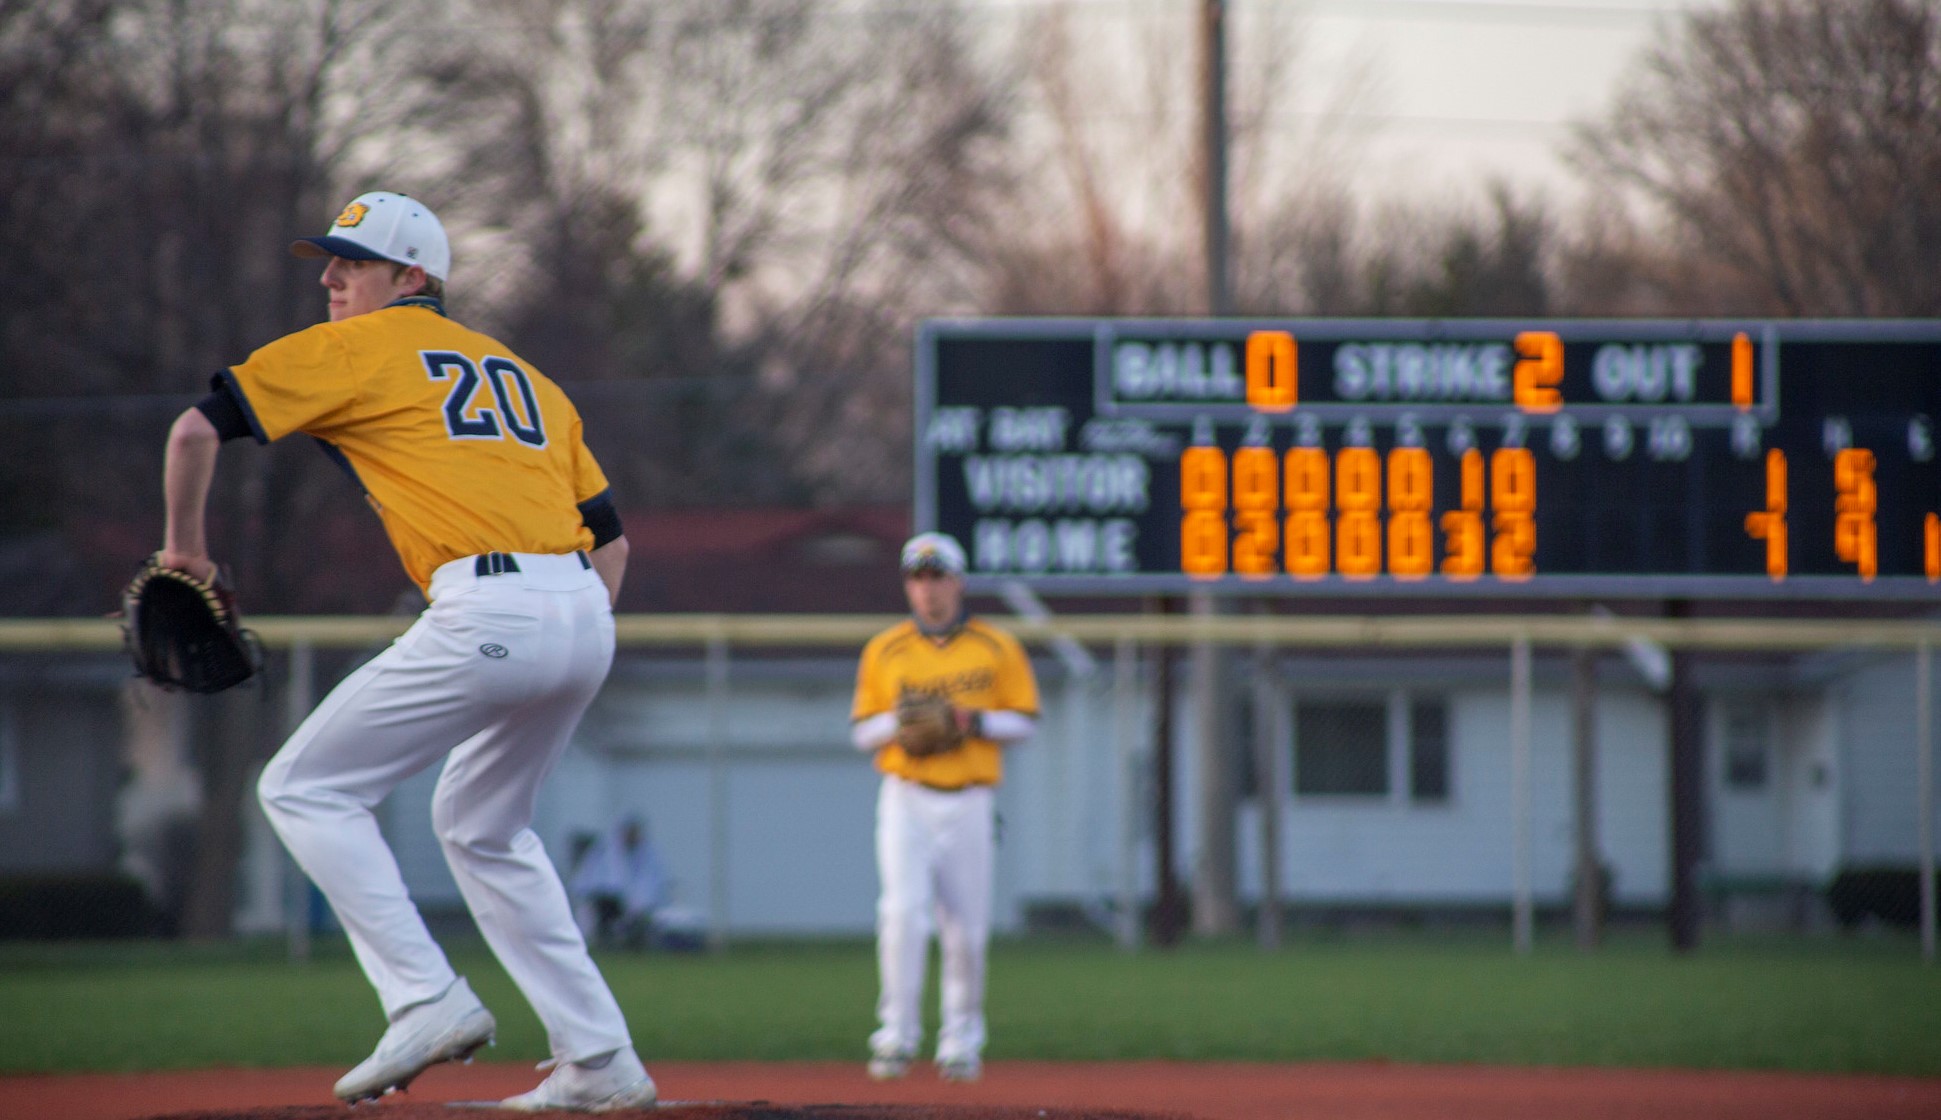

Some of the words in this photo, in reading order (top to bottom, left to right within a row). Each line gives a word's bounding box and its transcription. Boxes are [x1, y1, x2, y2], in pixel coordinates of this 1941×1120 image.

[418, 349, 548, 450] 20
[1115, 342, 1244, 398] BALL
[1245, 330, 1298, 412] 0
[1334, 342, 1512, 399] STRIKE
[1513, 331, 1564, 413] 2
[1592, 343, 1703, 400] OUT
[1731, 332, 1753, 412] 1
[963, 454, 1150, 513] VISITOR
[973, 519, 1140, 571] HOME
